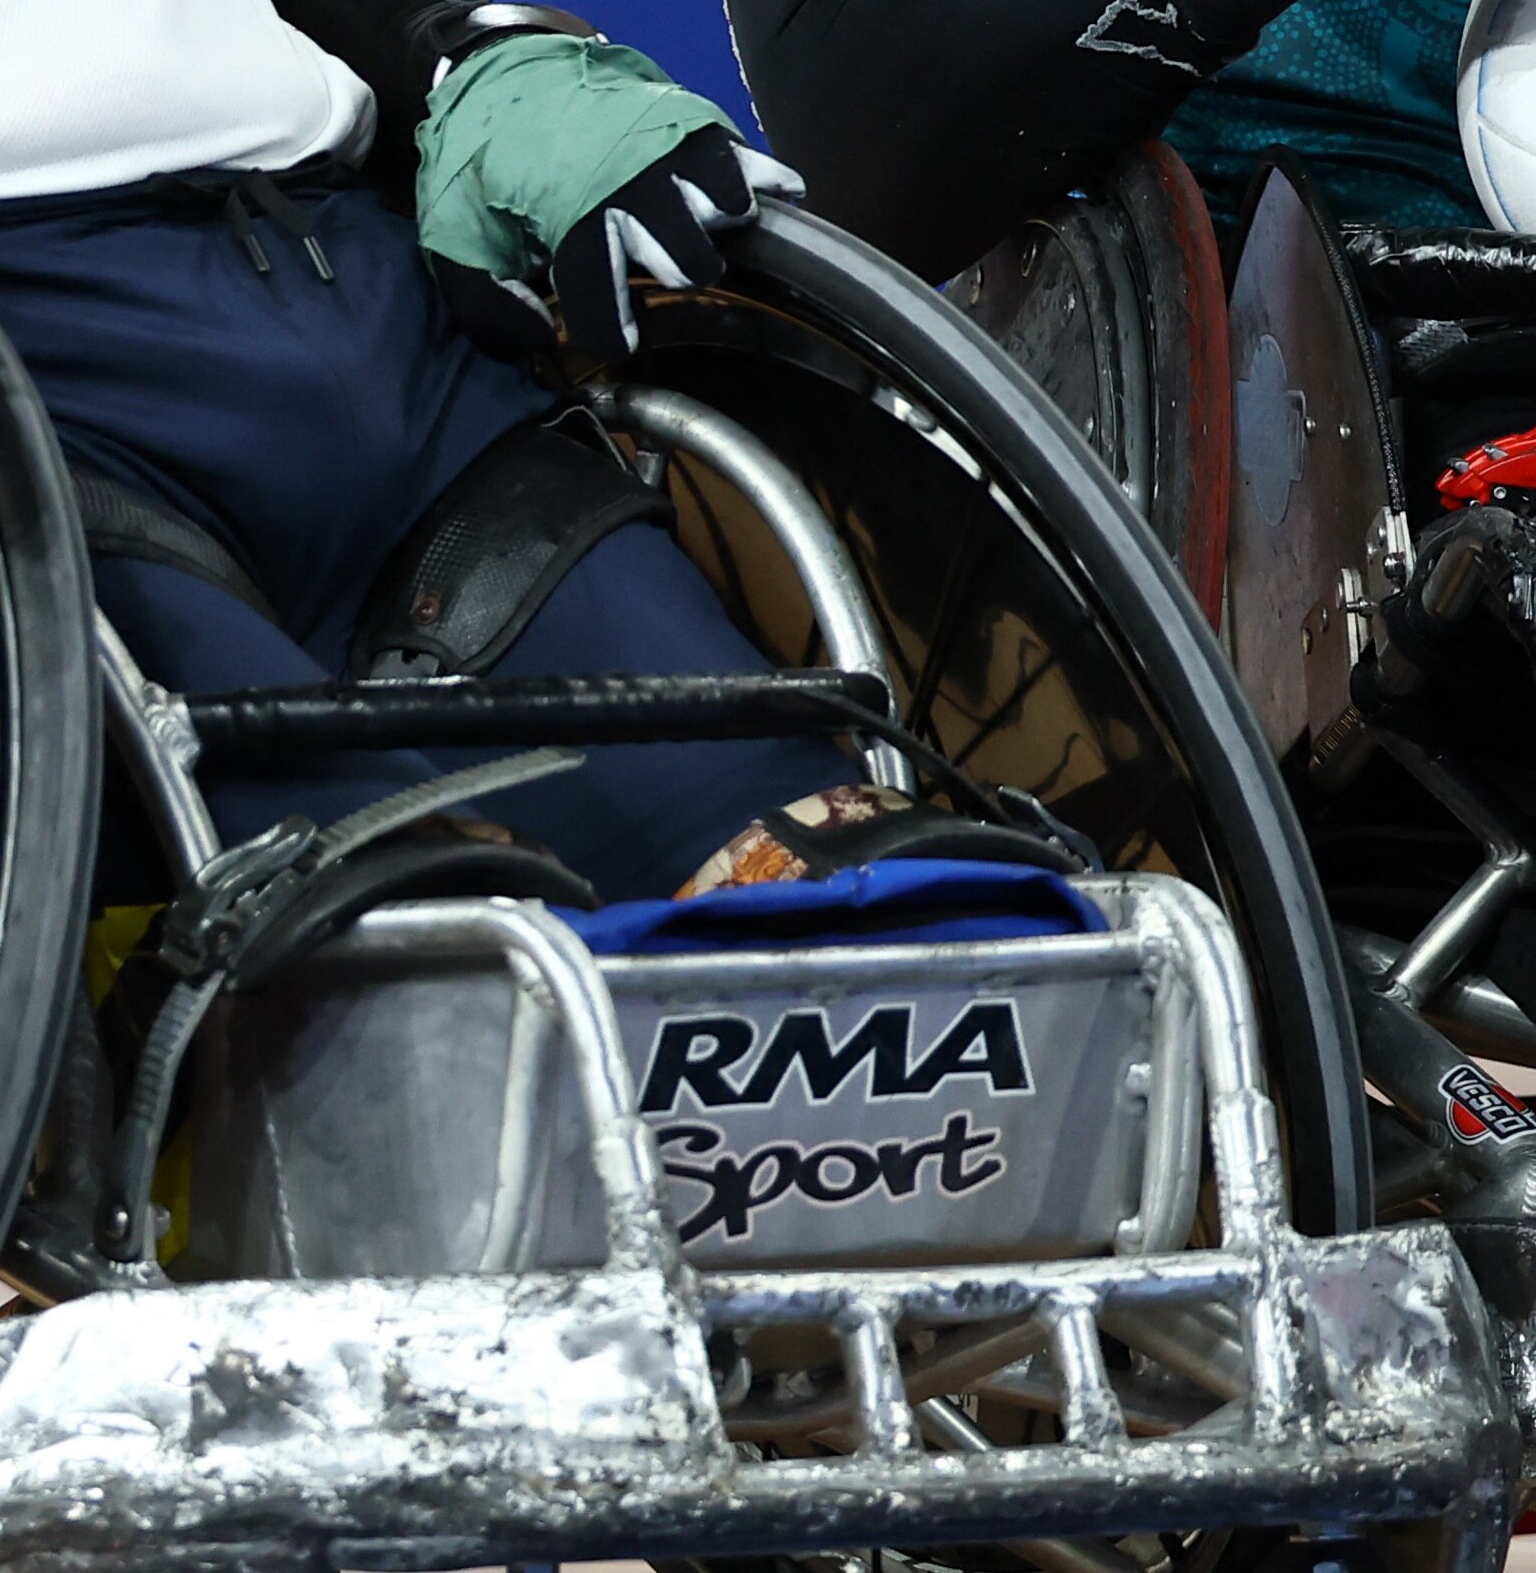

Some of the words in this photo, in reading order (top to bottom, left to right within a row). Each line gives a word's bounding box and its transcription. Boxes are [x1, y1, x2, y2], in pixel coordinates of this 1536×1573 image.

[639, 997, 1036, 1116] RMA
[1449, 1070, 1528, 1133] VESCO
[658, 1111, 1007, 1248] Sport
